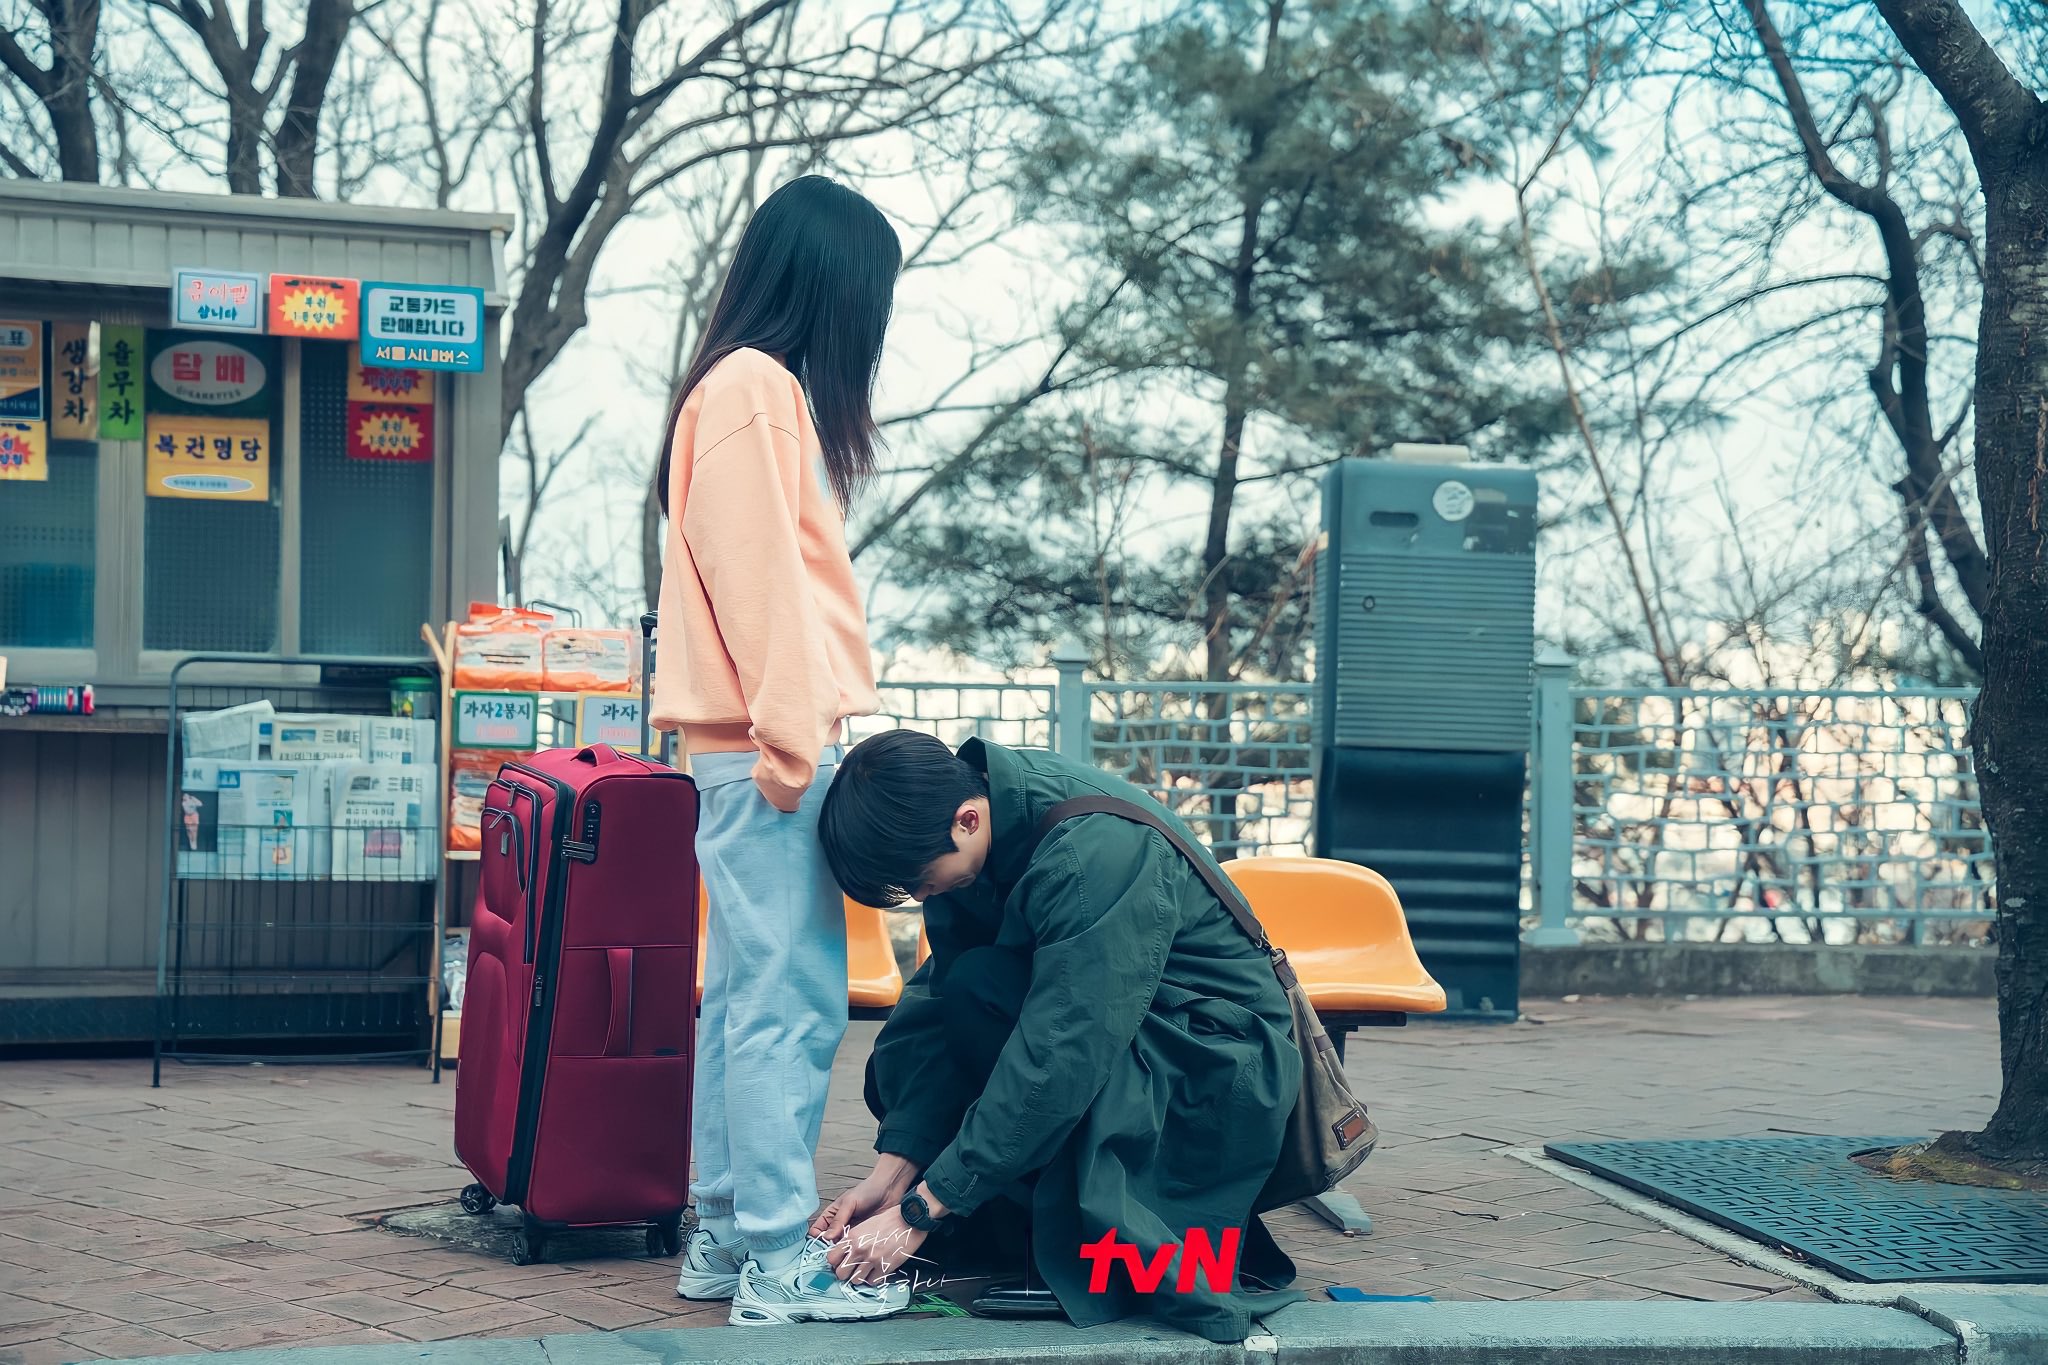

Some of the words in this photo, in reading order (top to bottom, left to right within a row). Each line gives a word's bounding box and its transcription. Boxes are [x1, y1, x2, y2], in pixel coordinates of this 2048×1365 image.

[389, 295, 456, 315] 교통카드
[380, 316, 465, 337] 판매합니다
[375, 346, 470, 365] 서시내버스
[172, 352, 245, 384] 담배
[62, 338, 89, 424] 생강차
[107, 339, 135, 426] 율무차
[464, 700, 531, 720] 과자2봉지
[601, 703, 639, 722] 과자
